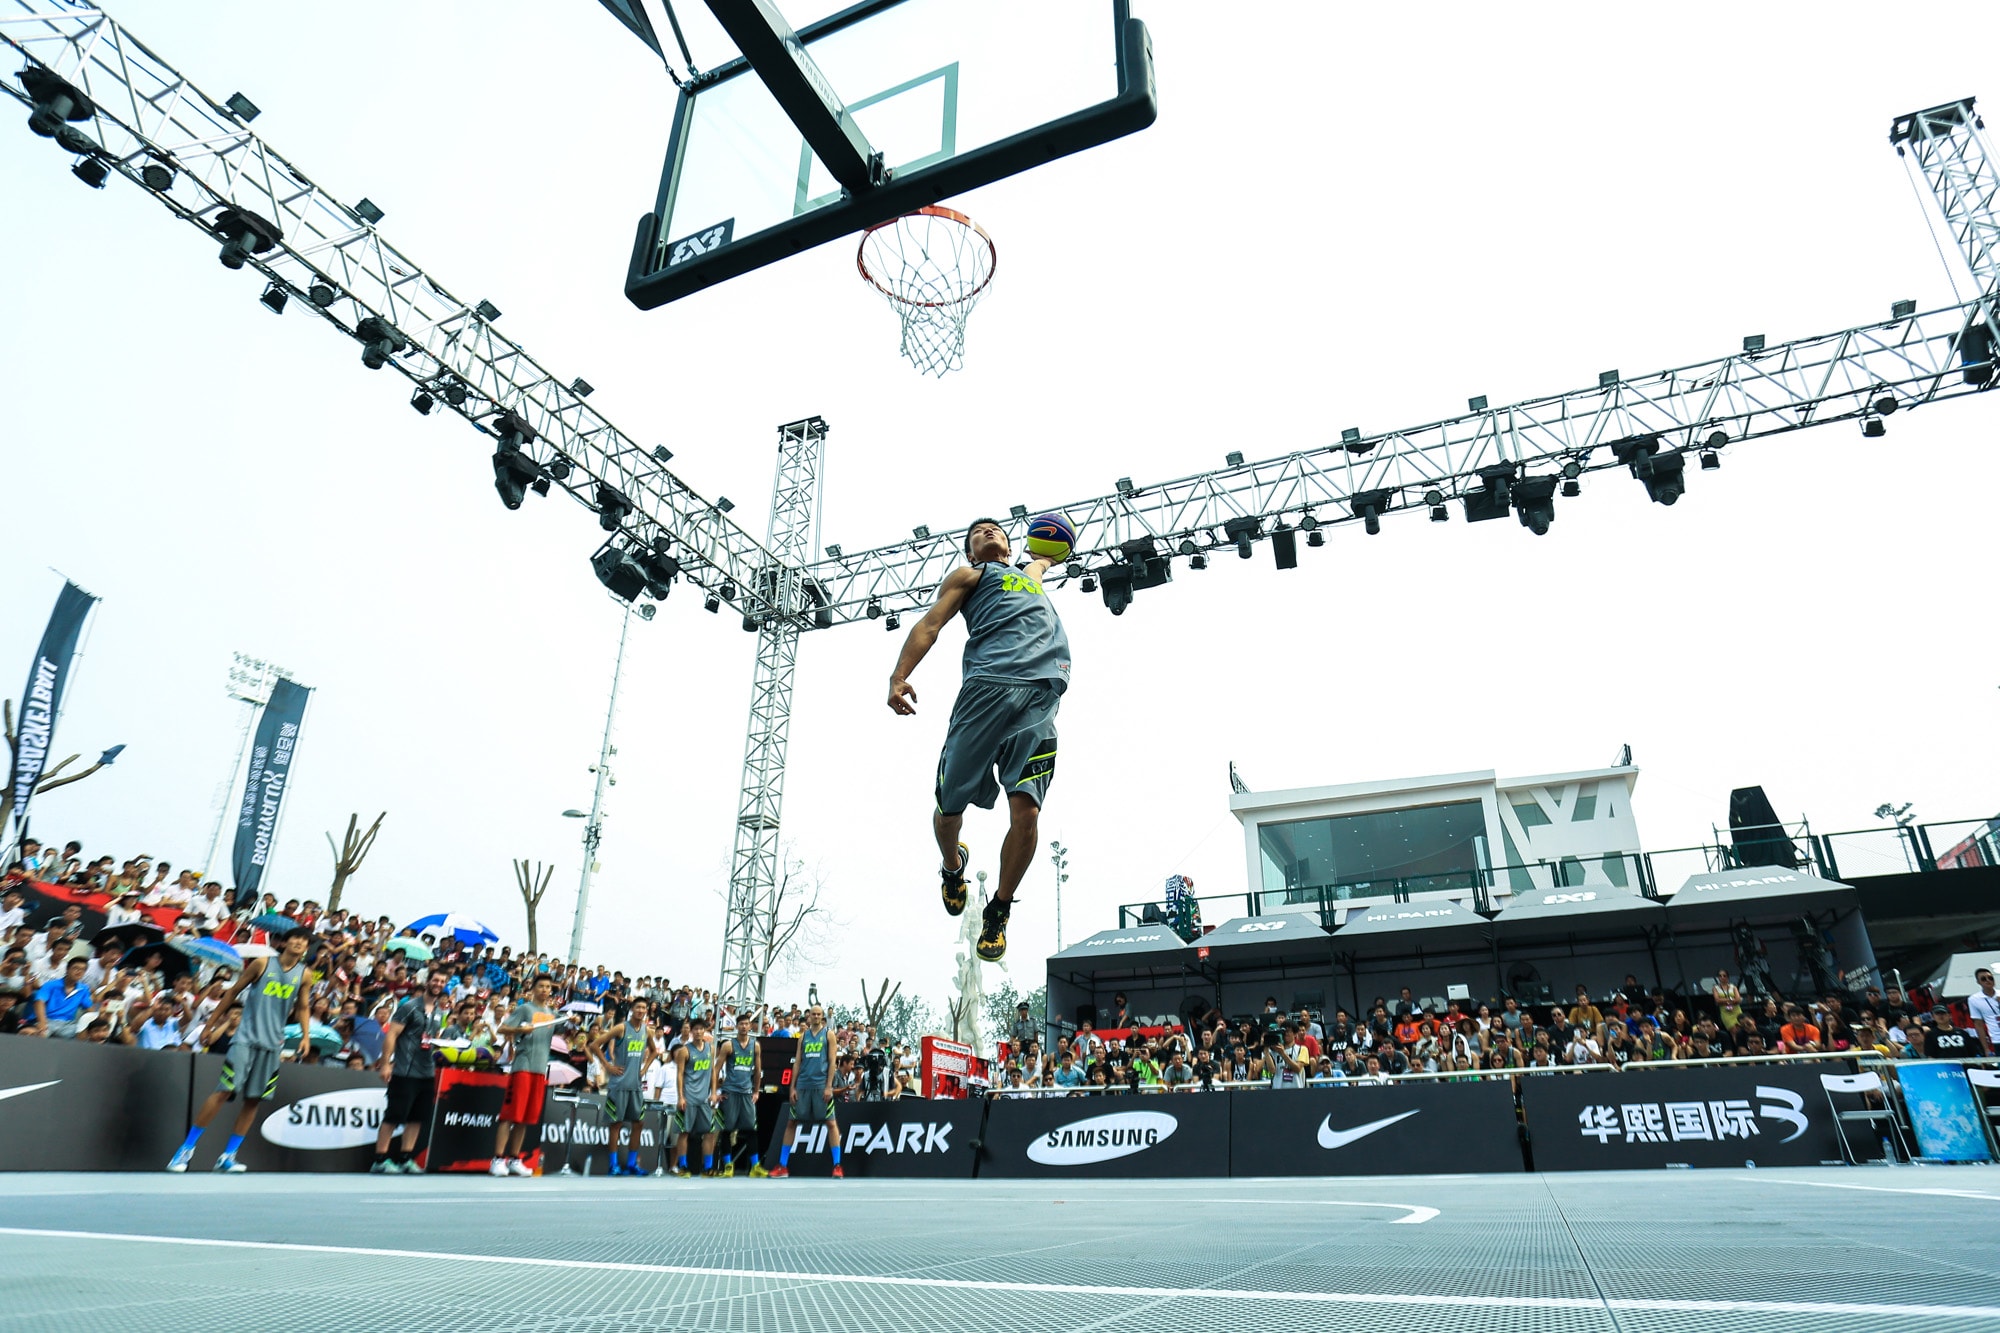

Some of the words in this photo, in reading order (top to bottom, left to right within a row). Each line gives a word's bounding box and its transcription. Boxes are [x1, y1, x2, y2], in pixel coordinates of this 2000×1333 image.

[781, 1068, 793, 1085] 8
[540, 1117, 655, 1147] orldtou.cm
[1578, 1099, 1761, 1144] 华熙国际
[1046, 1128, 1159, 1148] SAMSUNG
